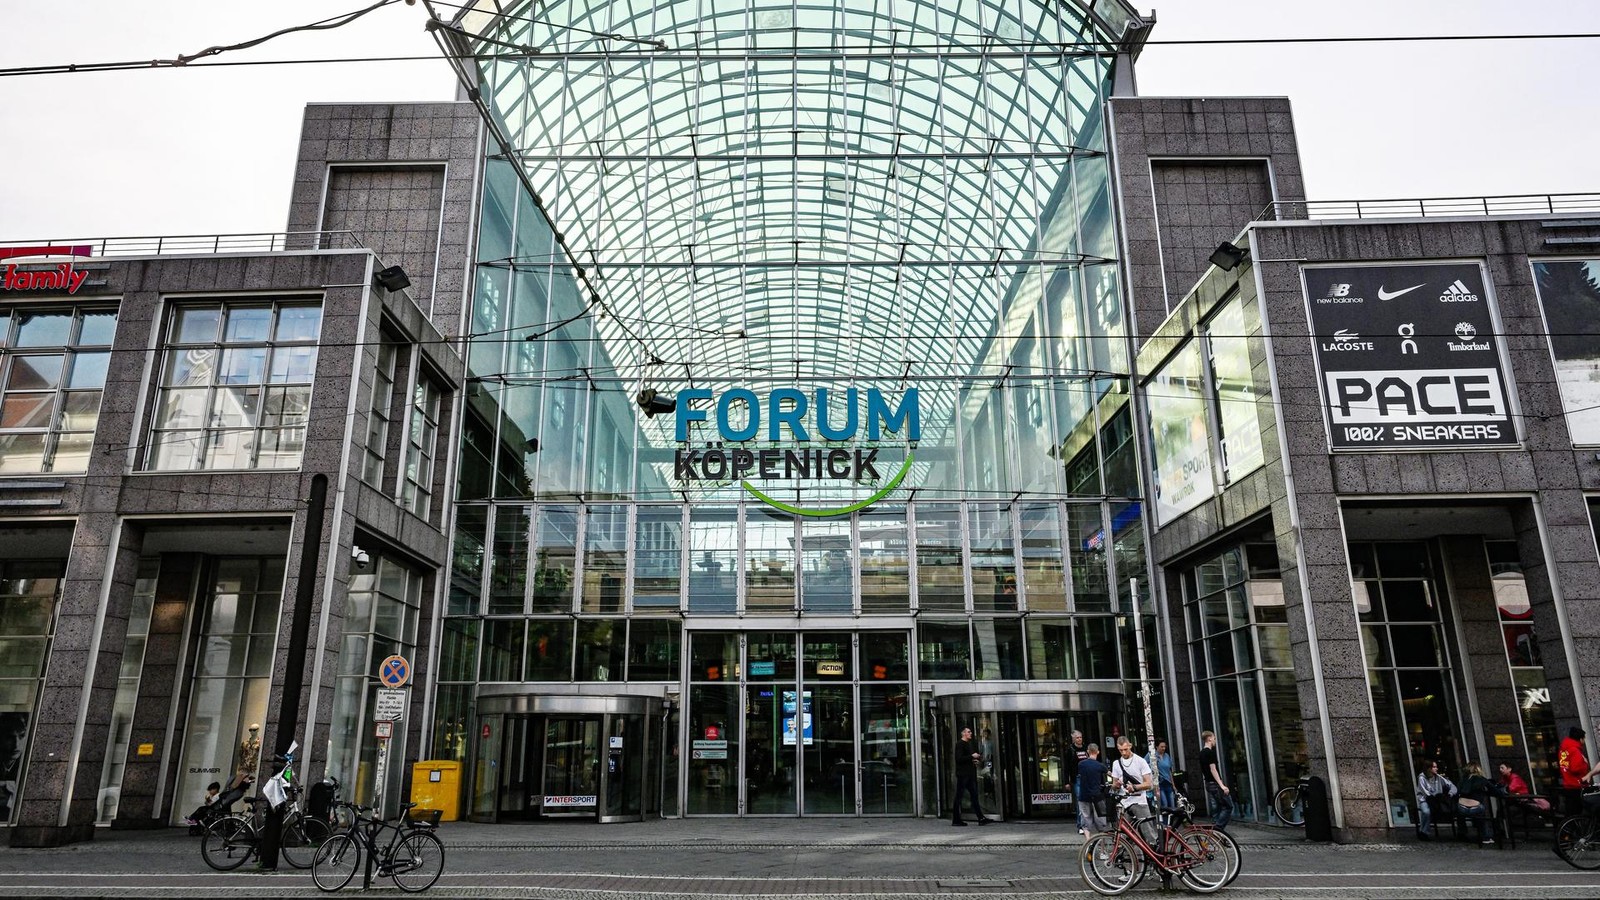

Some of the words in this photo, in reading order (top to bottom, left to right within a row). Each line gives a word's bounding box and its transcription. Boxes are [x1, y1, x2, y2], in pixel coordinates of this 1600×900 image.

[5, 263, 89, 294] family
[1439, 292, 1478, 303] adidas
[1322, 342, 1374, 352] LACOSTE
[1447, 341, 1490, 351] Timberland
[1336, 376, 1496, 417] PACE
[675, 387, 921, 442] FORUM
[1344, 427, 1384, 441] 100%
[1393, 424, 1501, 441] SNEAKERS
[674, 441, 881, 481] KÖPENICK
